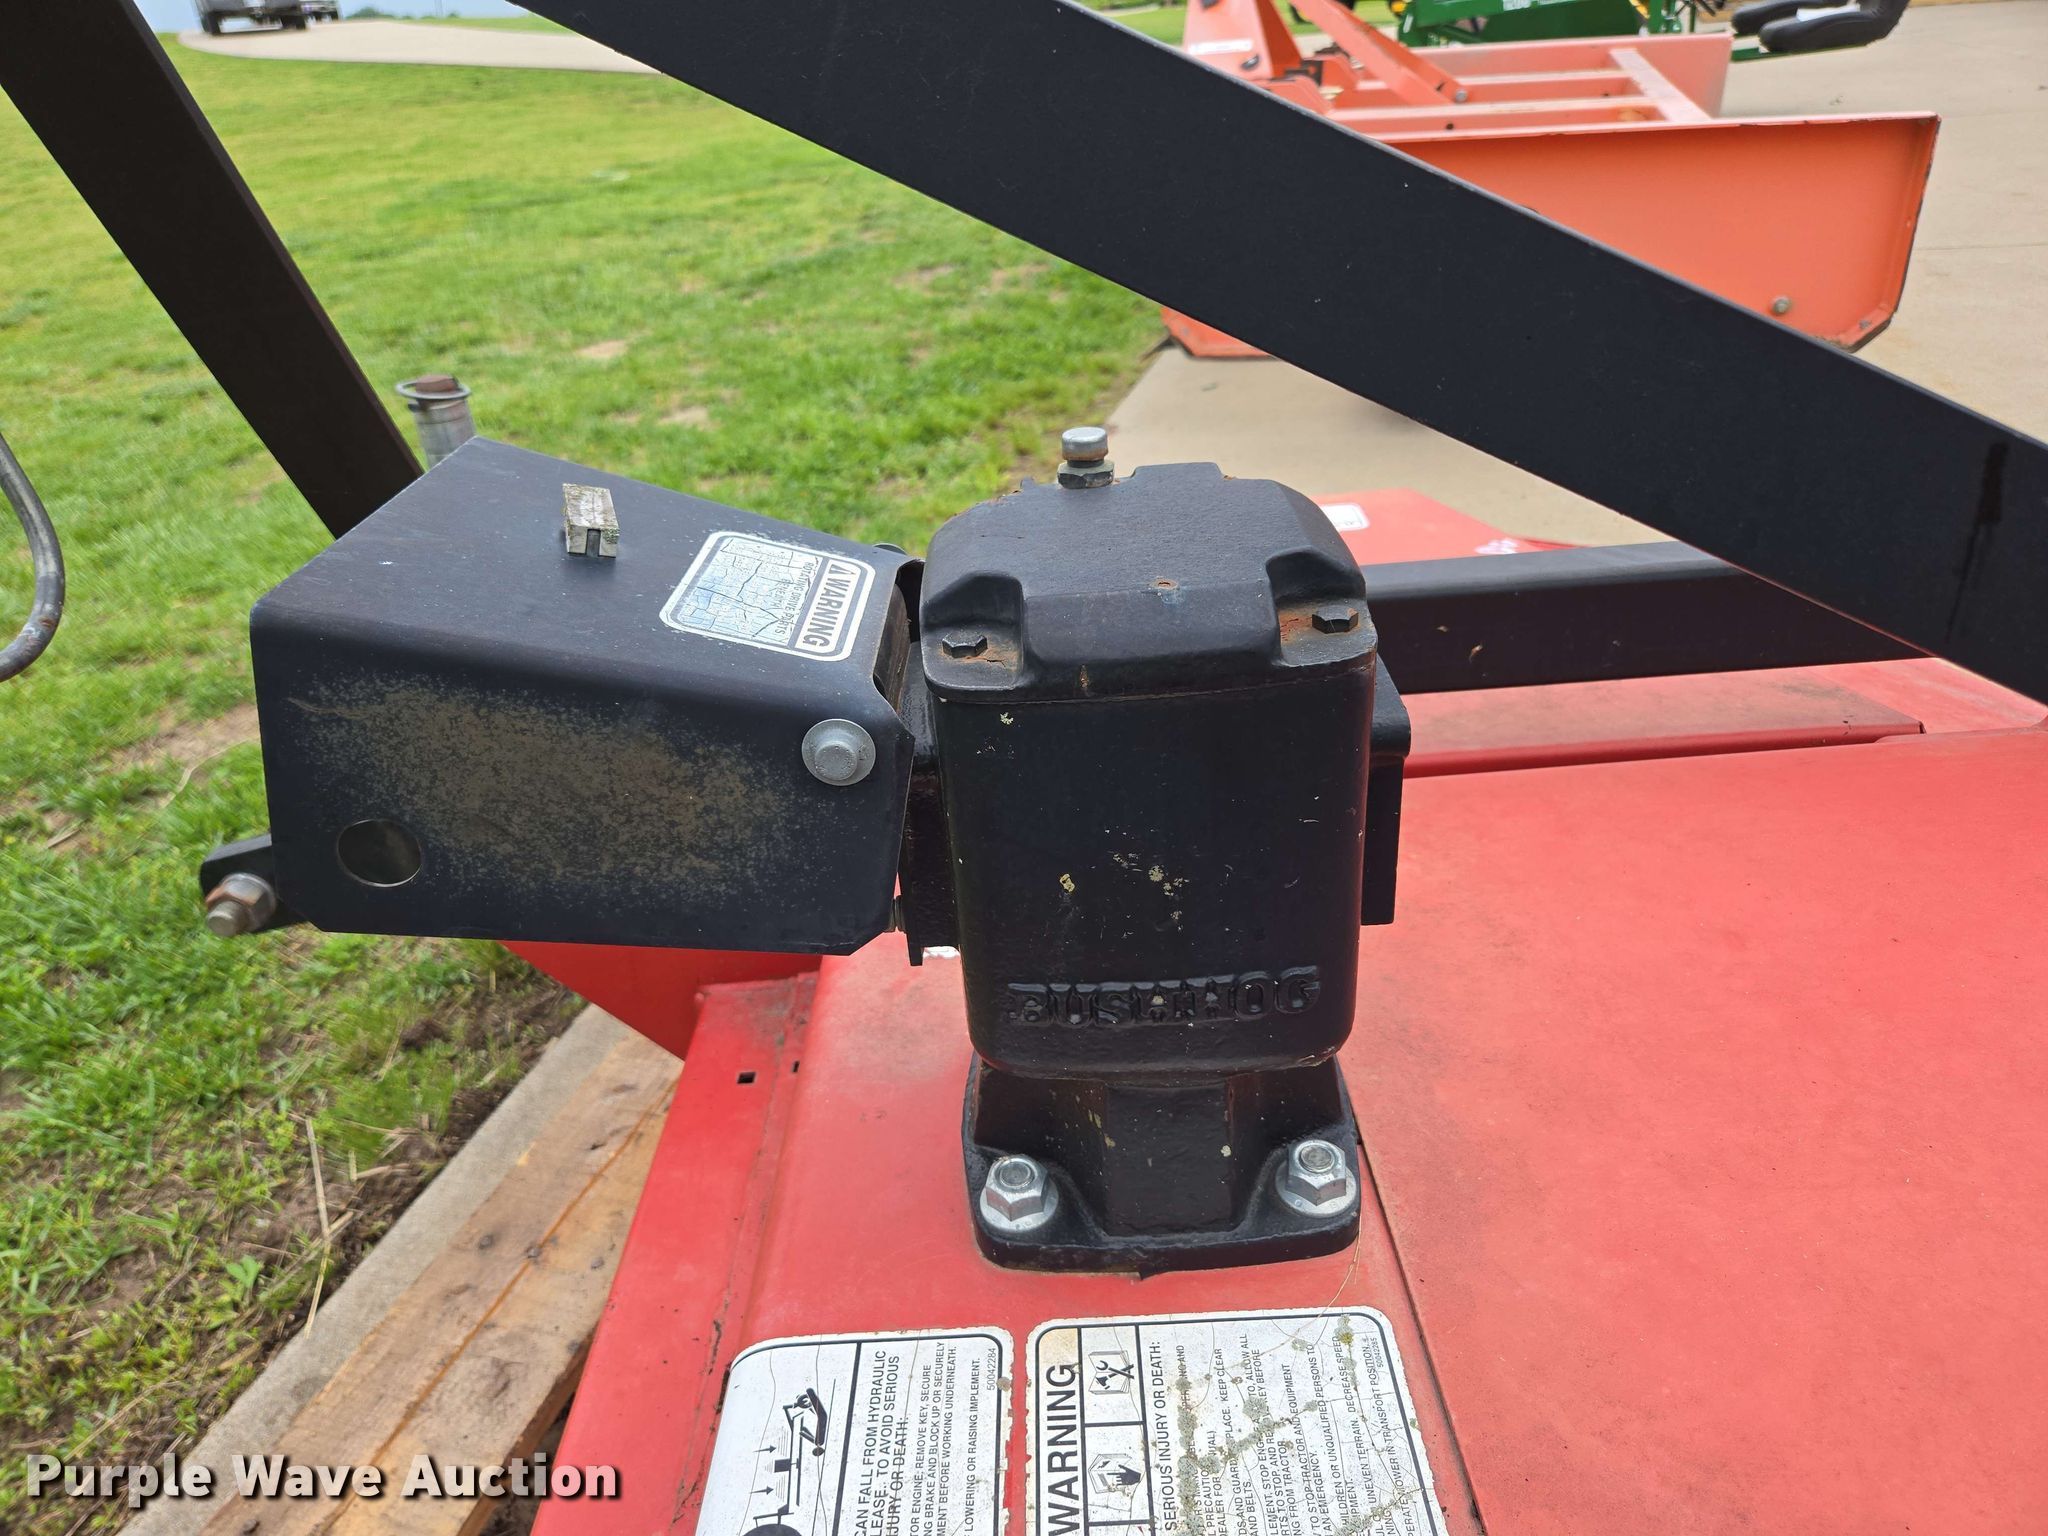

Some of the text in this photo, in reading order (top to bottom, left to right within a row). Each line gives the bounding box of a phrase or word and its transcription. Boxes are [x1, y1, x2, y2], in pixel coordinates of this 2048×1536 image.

[774, 562, 814, 635] ROTATING DRIVE PARTS
[802, 578, 851, 646] WARNING
[1239, 1333, 1248, 1348] ALL
[1306, 1344, 1316, 1355] TO
[934, 1342, 944, 1387] SECURELY
[946, 1346, 957, 1409] UNDERNEATH.
[987, 1348, 996, 1390] 50042284
[1214, 1348, 1225, 1377] CLEAR
[1242, 1351, 1255, 1381] ALLOW
[1252, 1349, 1264, 1383] BEFORE
[1309, 1357, 1324, 1398] PERSONS
[868, 1350, 886, 1422] HYDRAULIC
[885, 1356, 900, 1410] SERIOUS
[921, 1365, 931, 1401] SECURE
[933, 1390, 942, 1403] OR
[970, 1358, 980, 1412] IMPLEMENT.
[1219, 1380, 1229, 1402] KEEP
[1282, 1363, 1299, 1414] EQUIPMENT
[1338, 1366, 1356, 1413] DECREASE
[919, 1404, 929, 1424] KEY,
[932, 1406, 940, 1418] UP
[1222, 1406, 1234, 1439] PLACE.
[1292, 1415, 1302, 1436] AND
[1371, 1388, 1391, 1443] TRANSPORT
[863, 1427, 877, 1465] FROM
[879, 1415, 894, 1454] AVOID
[916, 1427, 927, 1468] REMOVE
[930, 1420, 940, 1454] BLOCK
[943, 1412, 953, 1458] WORKING
[968, 1414, 978, 1453] RAISING
[1149, 1341, 1177, 1530] SERIOUS INJURY OR DEATH:
[1317, 1400, 1338, 1461] UNQUALIFIED
[1351, 1418, 1368, 1460] TERRAIN.
[967, 1457, 976, 1471] OR
[1046, 1363, 1080, 1536] WARNING
[1267, 1446, 1278, 1467] AND
[1296, 1438, 1312, 1485] TRACTOR
[1386, 1446, 1395, 1455] IN
[876, 1459, 889, 1477] TO
[886, 1417, 908, 1536] JURY OR DEATH:
[928, 1458, 937, 1478] AND
[939, 1462, 950, 1503] BEFORE
[1229, 1459, 1241, 1494] GUARD
[1258, 1464, 1271, 1489] STOP
[1310, 1450, 1329, 1514] EMERGENCY.
[1331, 1464, 1341, 1478] OR
[1360, 1463, 1377, 1503] UNEVEN
[858, 1469, 873, 1504] FALL
[925, 1481, 935, 1518] BRAKE
[965, 1475, 976, 1531] LOWERING
[1212, 1477, 1223, 1496] FOR
[1286, 1488, 1298, 1518] FROM
[1305, 1486, 1316, 1513] STOP
[1234, 1496, 1244, 1517] AND
[1275, 1498, 1286, 1512] TO
[1309, 1516, 1319, 1530] TO
[1323, 1517, 1334, 1532] AN
